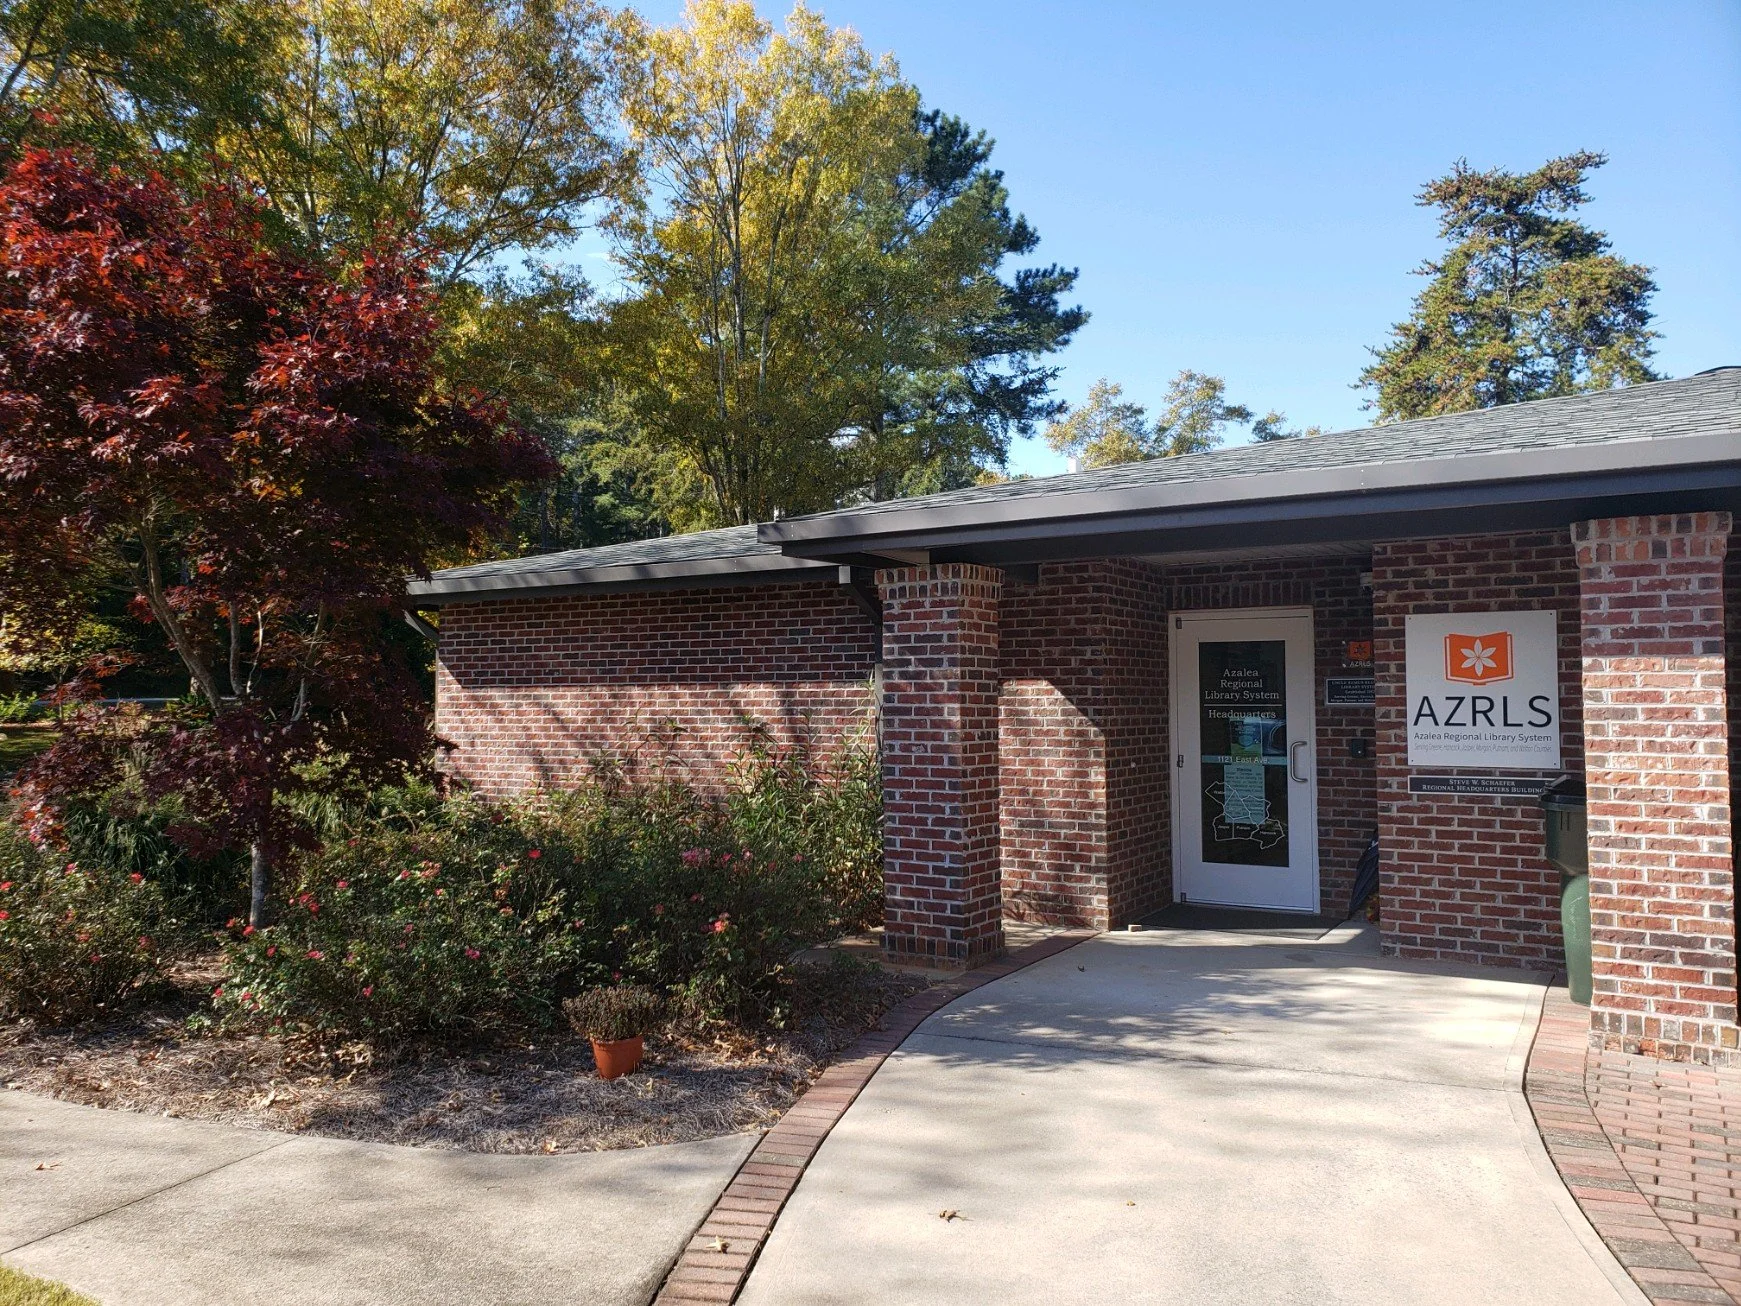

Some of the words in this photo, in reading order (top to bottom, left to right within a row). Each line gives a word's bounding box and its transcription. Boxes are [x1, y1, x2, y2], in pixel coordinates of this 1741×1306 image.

[1223, 668, 1259, 677] Azalea
[1220, 679, 1263, 690] Regional
[1204, 690, 1240, 702] Library
[1243, 690, 1280, 702] System
[1208, 709, 1277, 720] Headquarters
[1413, 695, 1552, 728] AZRLS
[1413, 732, 1442, 741] Azalea
[1443, 732, 1482, 743] Regional
[1484, 732, 1516, 743] Library
[1518, 733, 1552, 744] System
[1236, 756, 1252, 764] East
[1253, 756, 1270, 764] Ave.
